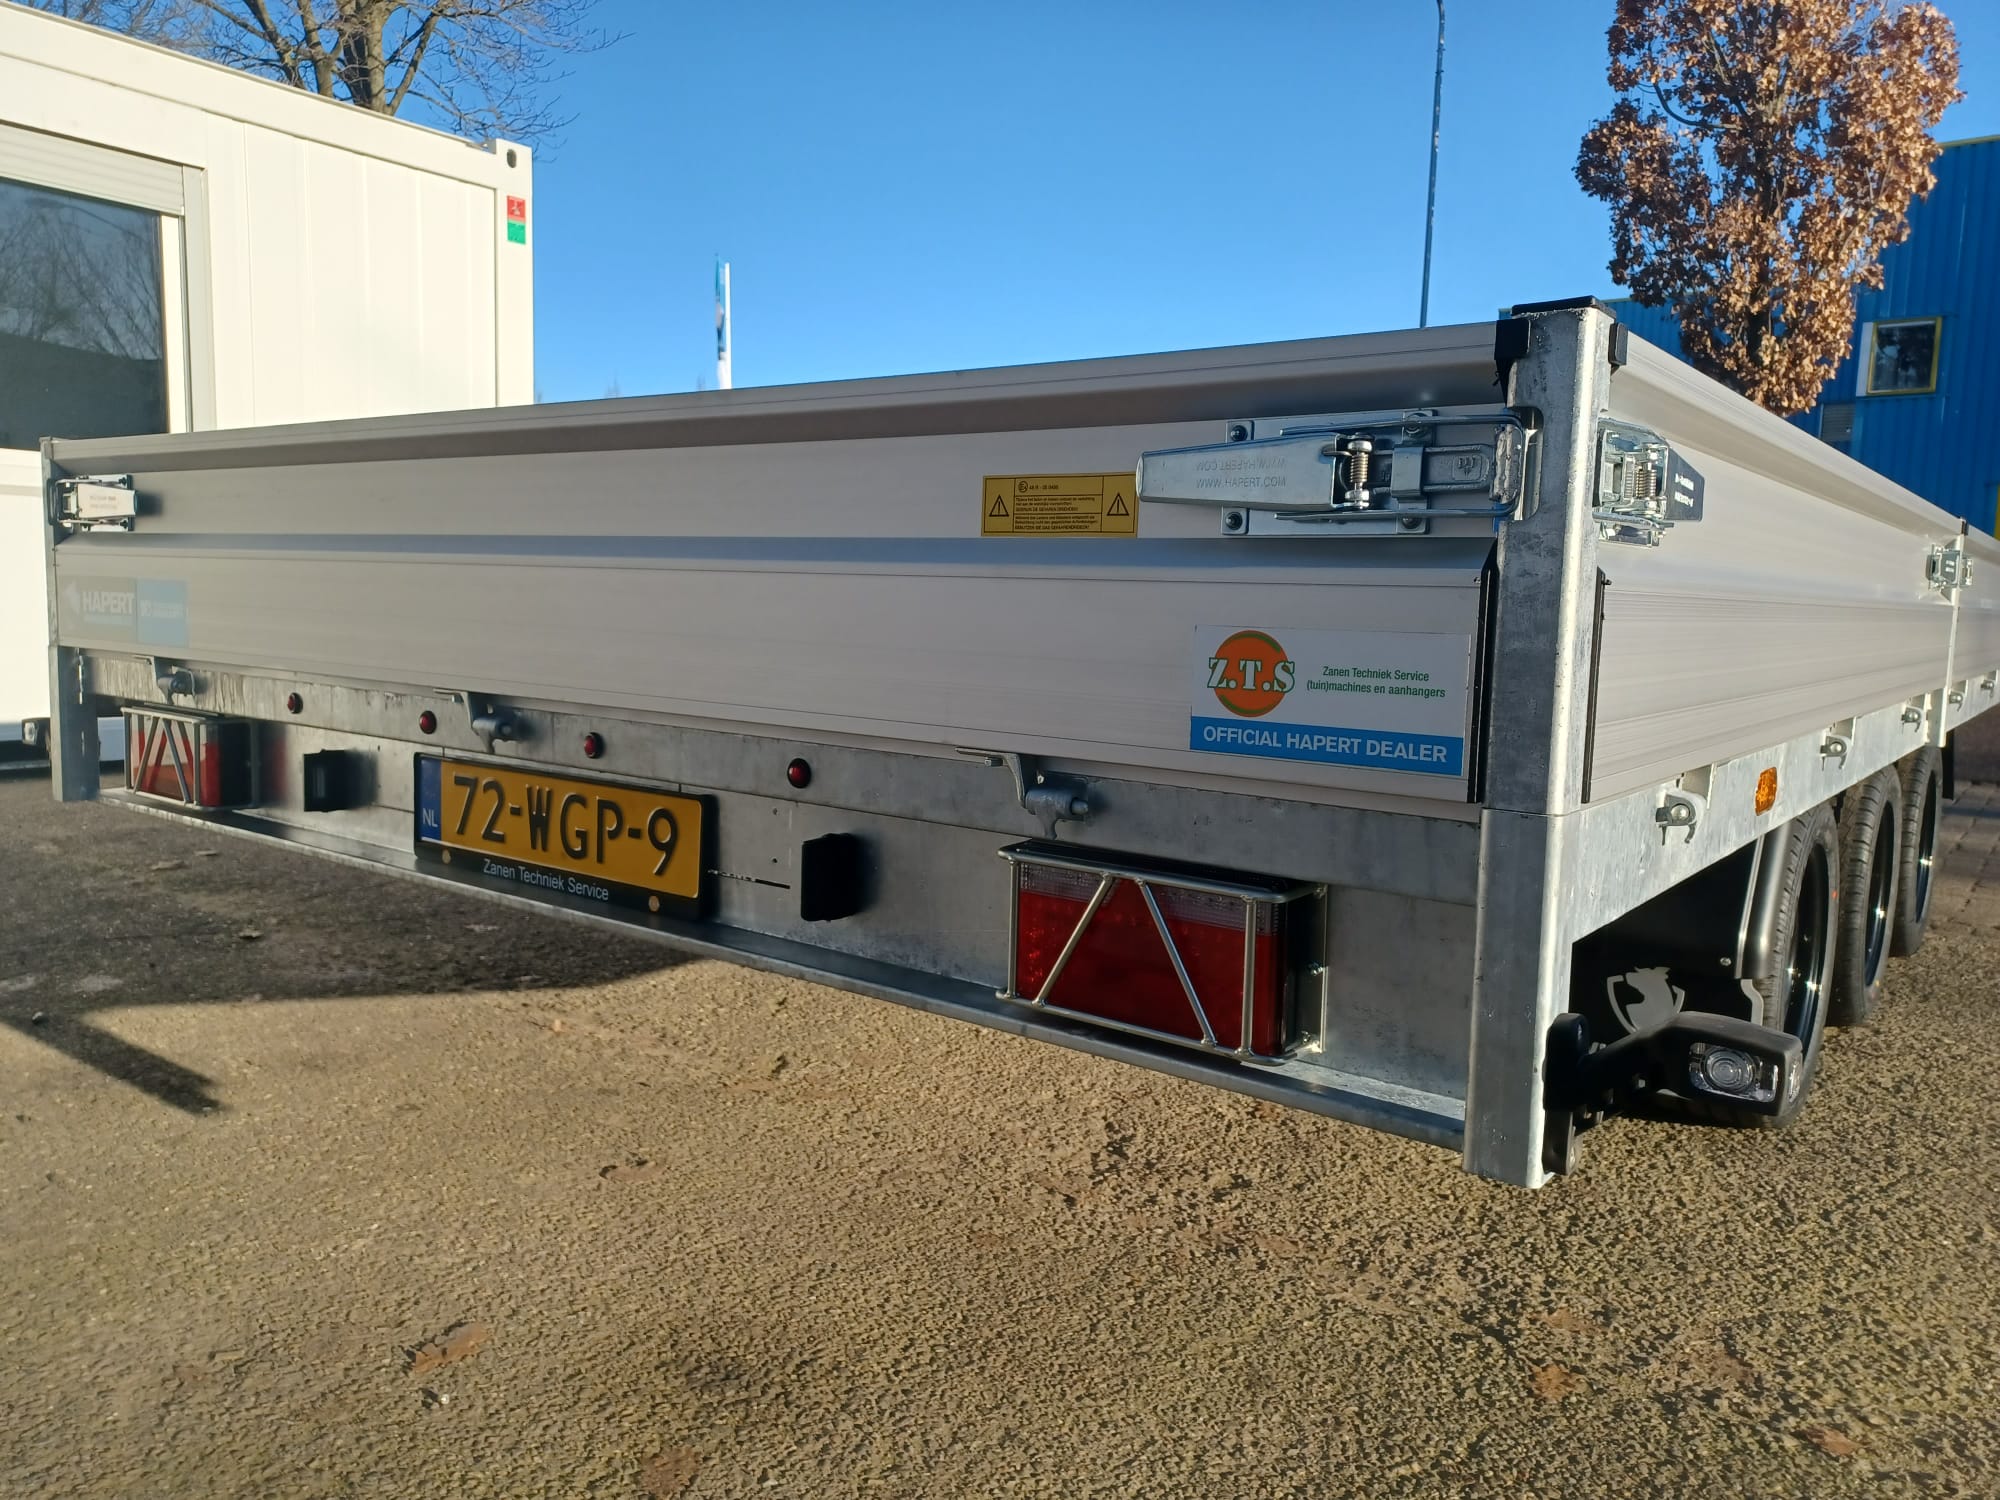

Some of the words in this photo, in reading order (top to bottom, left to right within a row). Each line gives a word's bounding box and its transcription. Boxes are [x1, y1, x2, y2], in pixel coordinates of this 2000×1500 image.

[1196, 476, 1287, 488] WWW.HAPERT.COM
[82, 591, 135, 614] HAPERT
[1207, 656, 1295, 693] Z.T.S
[1323, 666, 1350, 677] Zanen
[1352, 667, 1392, 680] Techniek
[1394, 670, 1429, 682] Service
[1306, 680, 1372, 694] (tuin)machines
[1373, 685, 1386, 694] en
[1388, 686, 1446, 699] aanhangers
[1203, 725, 1282, 748] OFFICIAL
[1287, 732, 1362, 754] HAPERT
[1366, 739, 1447, 763] DEALER
[422, 807, 438, 828] NL
[453, 772, 679, 877] 72-WGP-9
[483, 859, 516, 881] Zanen
[518, 866, 565, 891] Techniek
[568, 877, 609, 902] Service
